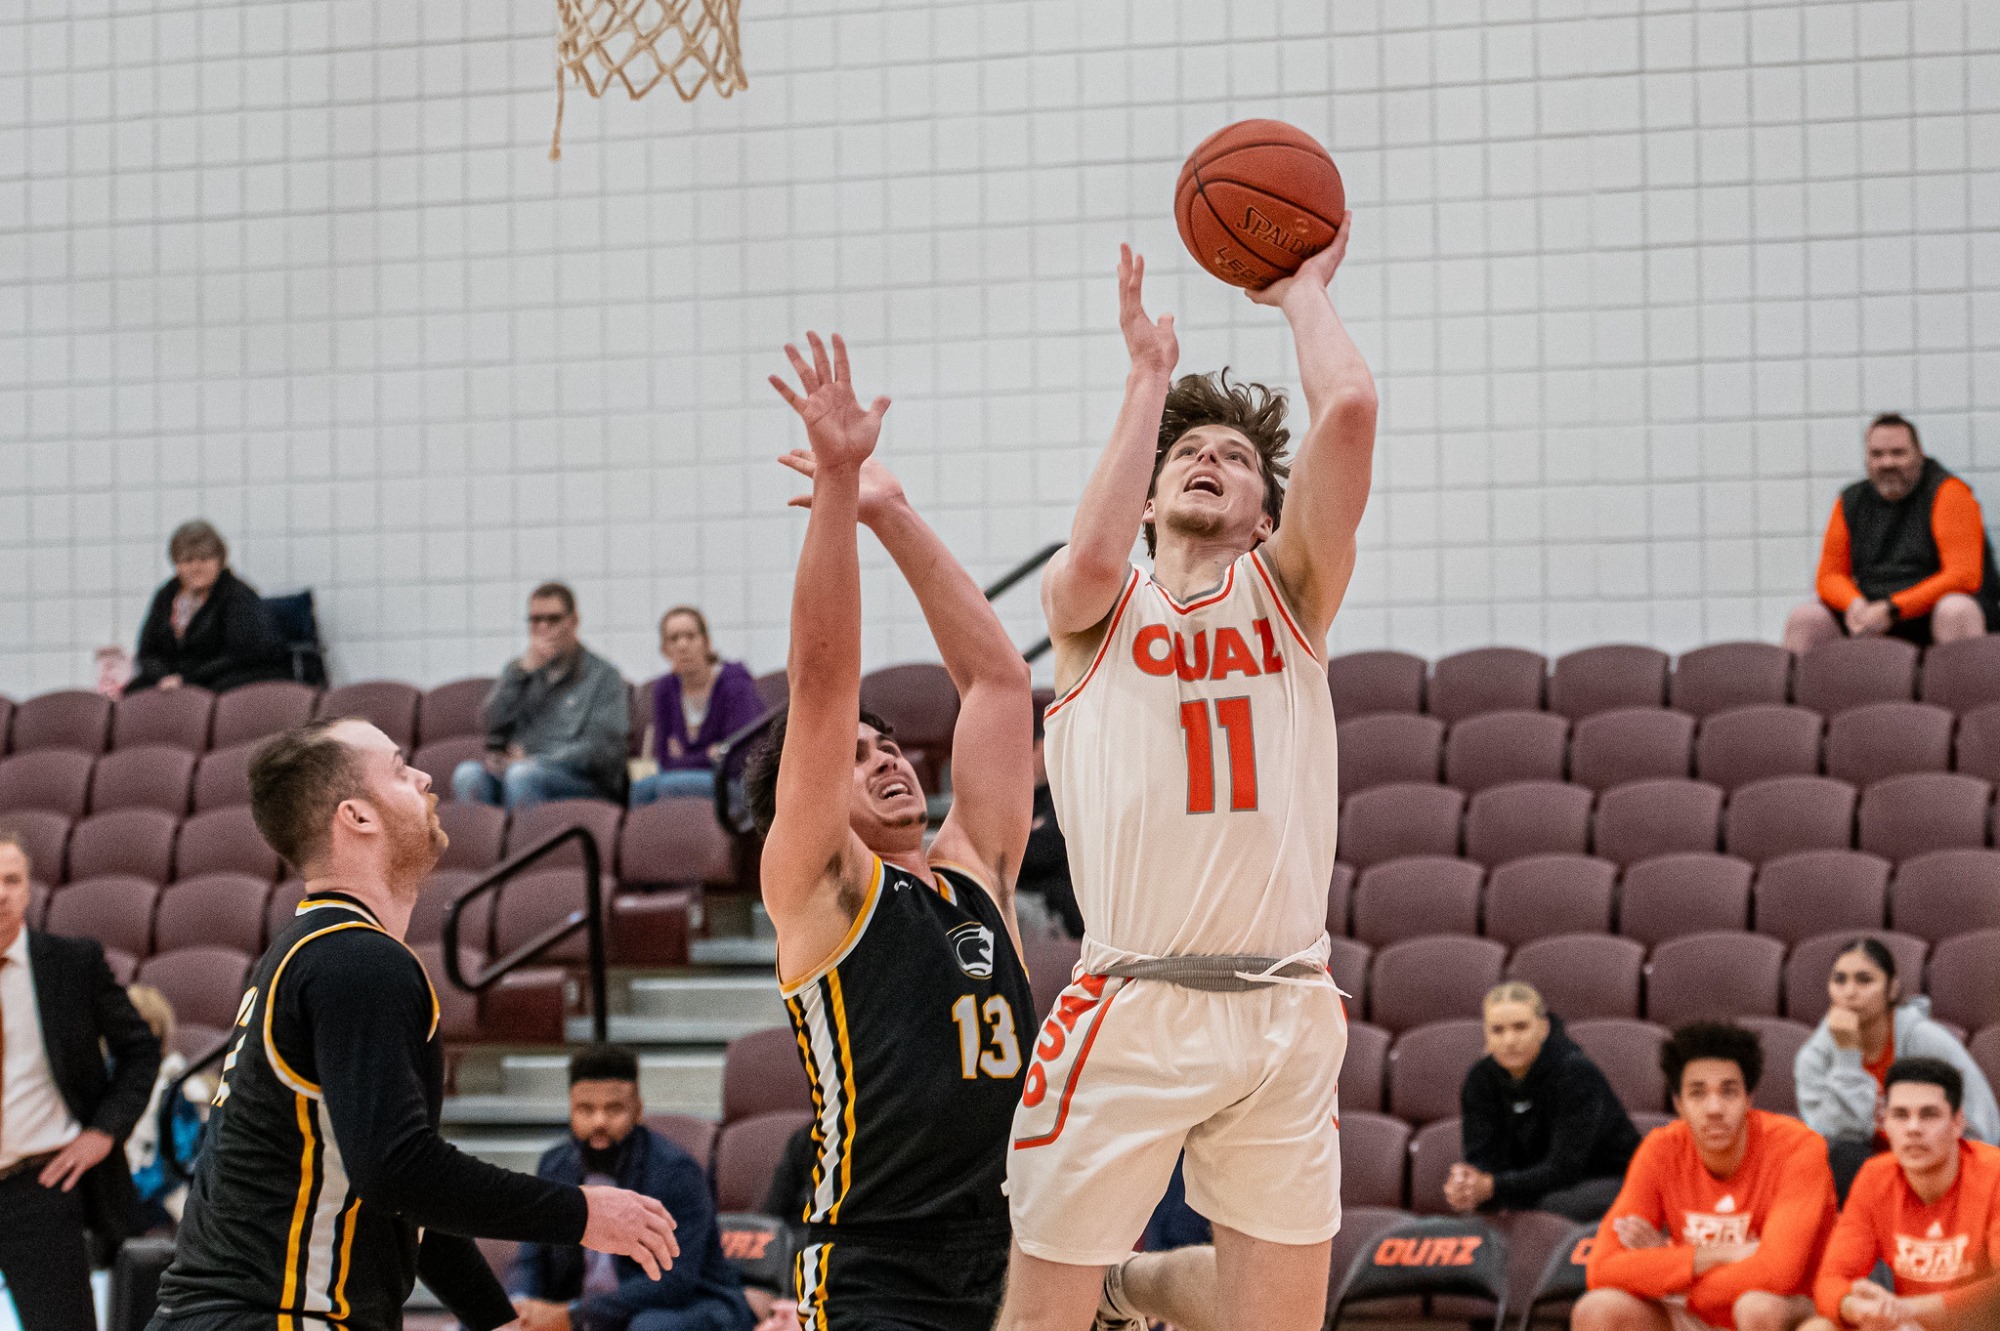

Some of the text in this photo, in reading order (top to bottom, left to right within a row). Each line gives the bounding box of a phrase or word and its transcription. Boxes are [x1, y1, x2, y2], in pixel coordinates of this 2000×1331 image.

[1236, 205, 1318, 257] SPALD
[1180, 695, 1258, 815] 11
[952, 994, 1022, 1079] 13
[1374, 1236, 1483, 1266] OUAZ
